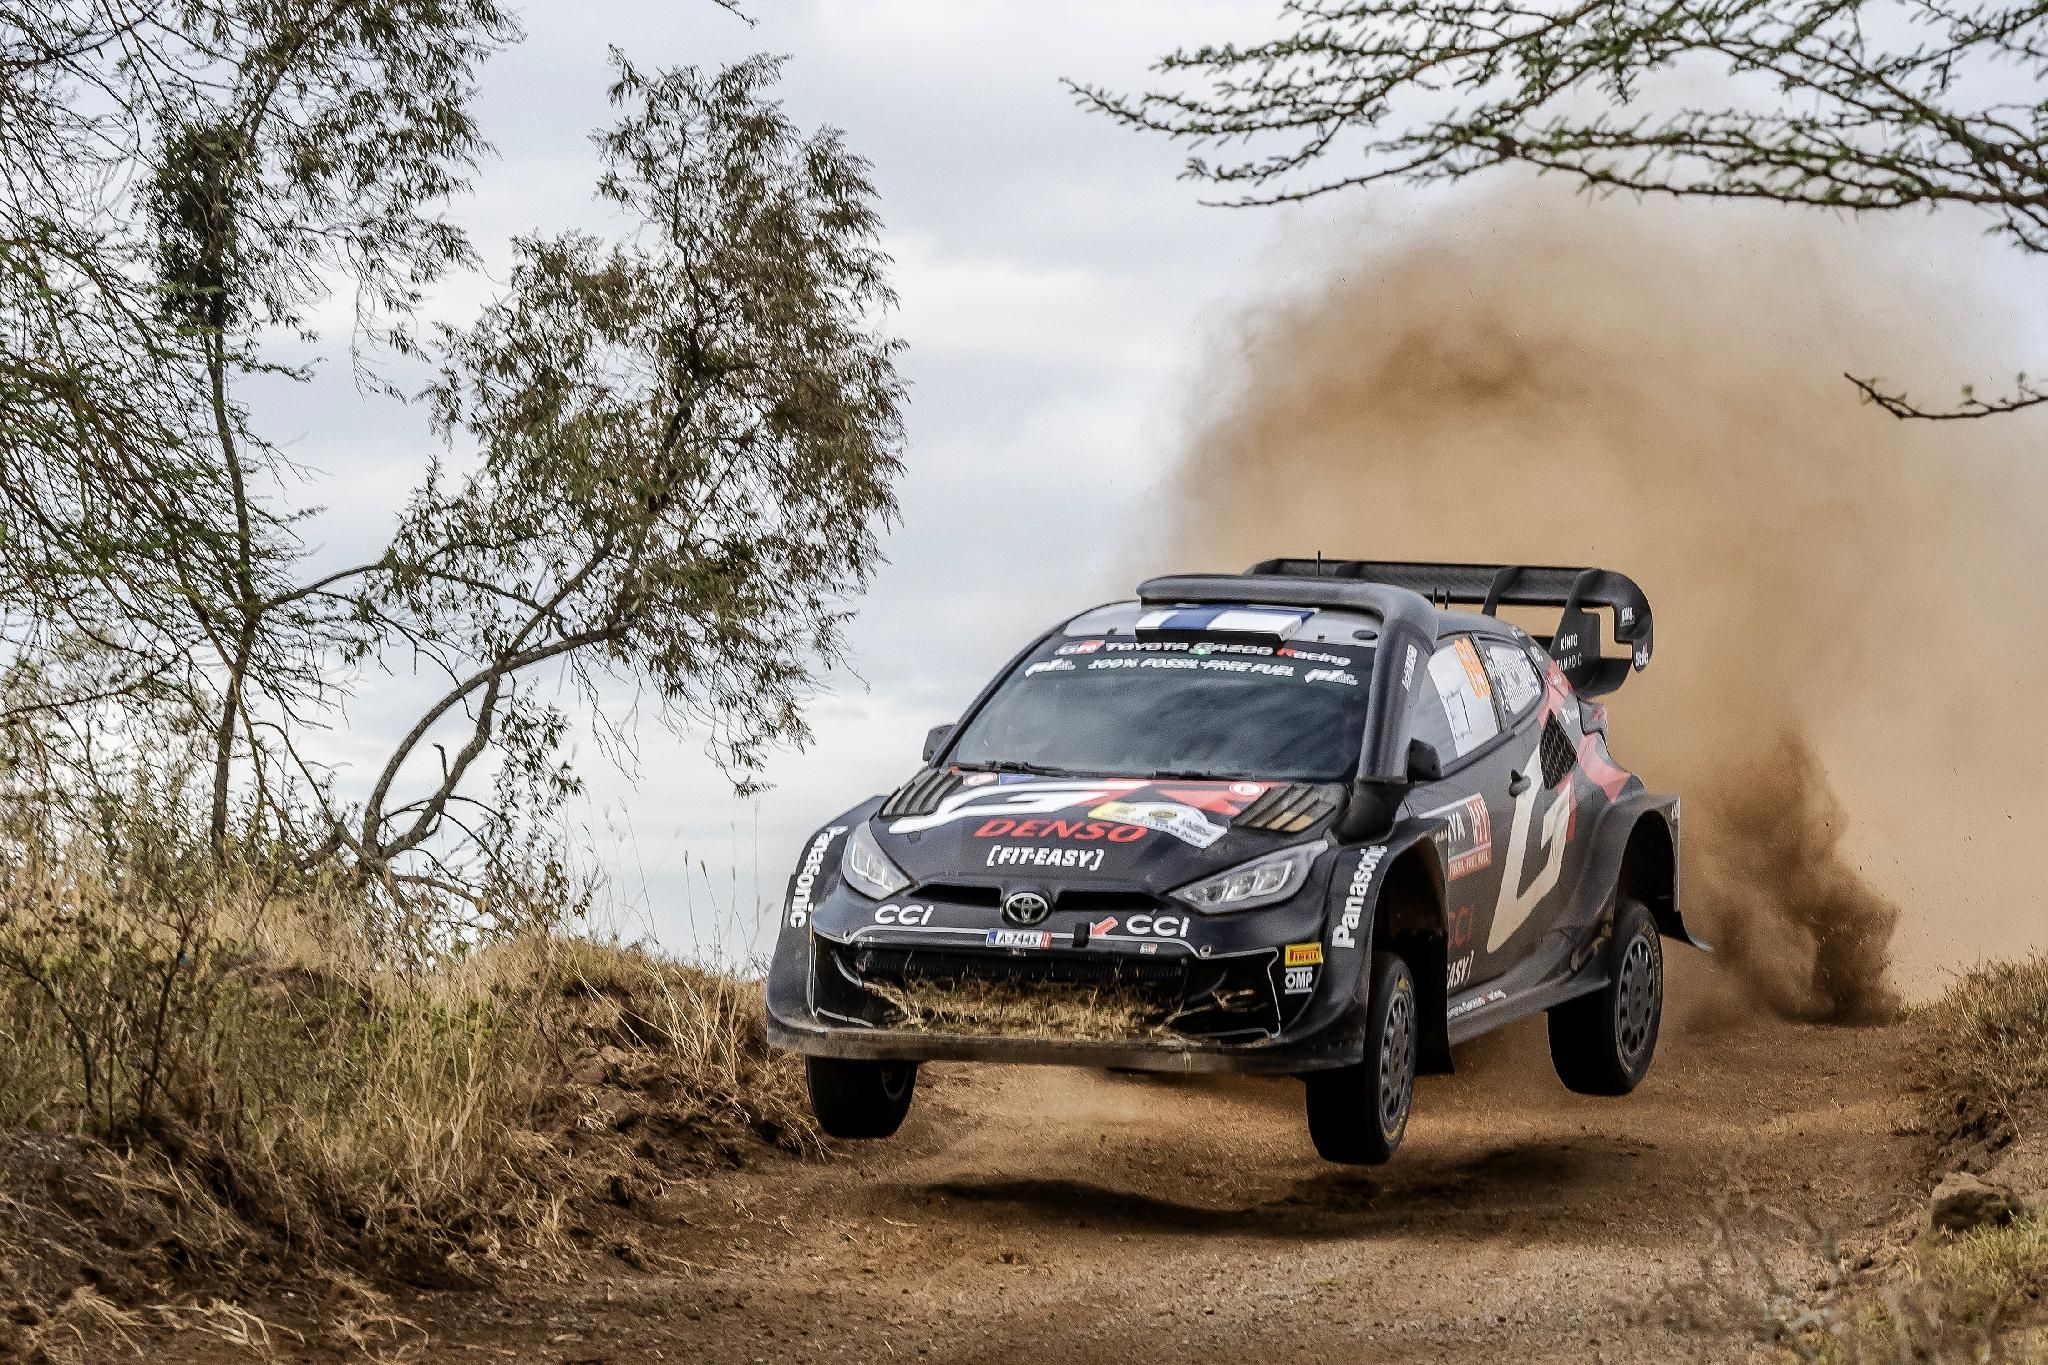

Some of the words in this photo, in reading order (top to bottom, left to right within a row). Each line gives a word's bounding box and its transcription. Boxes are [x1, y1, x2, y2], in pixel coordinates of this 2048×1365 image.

[1105, 642, 1189, 652] TOYOTA
[974, 818, 1148, 843] DENSO
[1332, 845, 1388, 949] Panasonic
[874, 903, 935, 926] CCI
[1126, 914, 1190, 938] CCI
[1285, 969, 1313, 991] OMP
